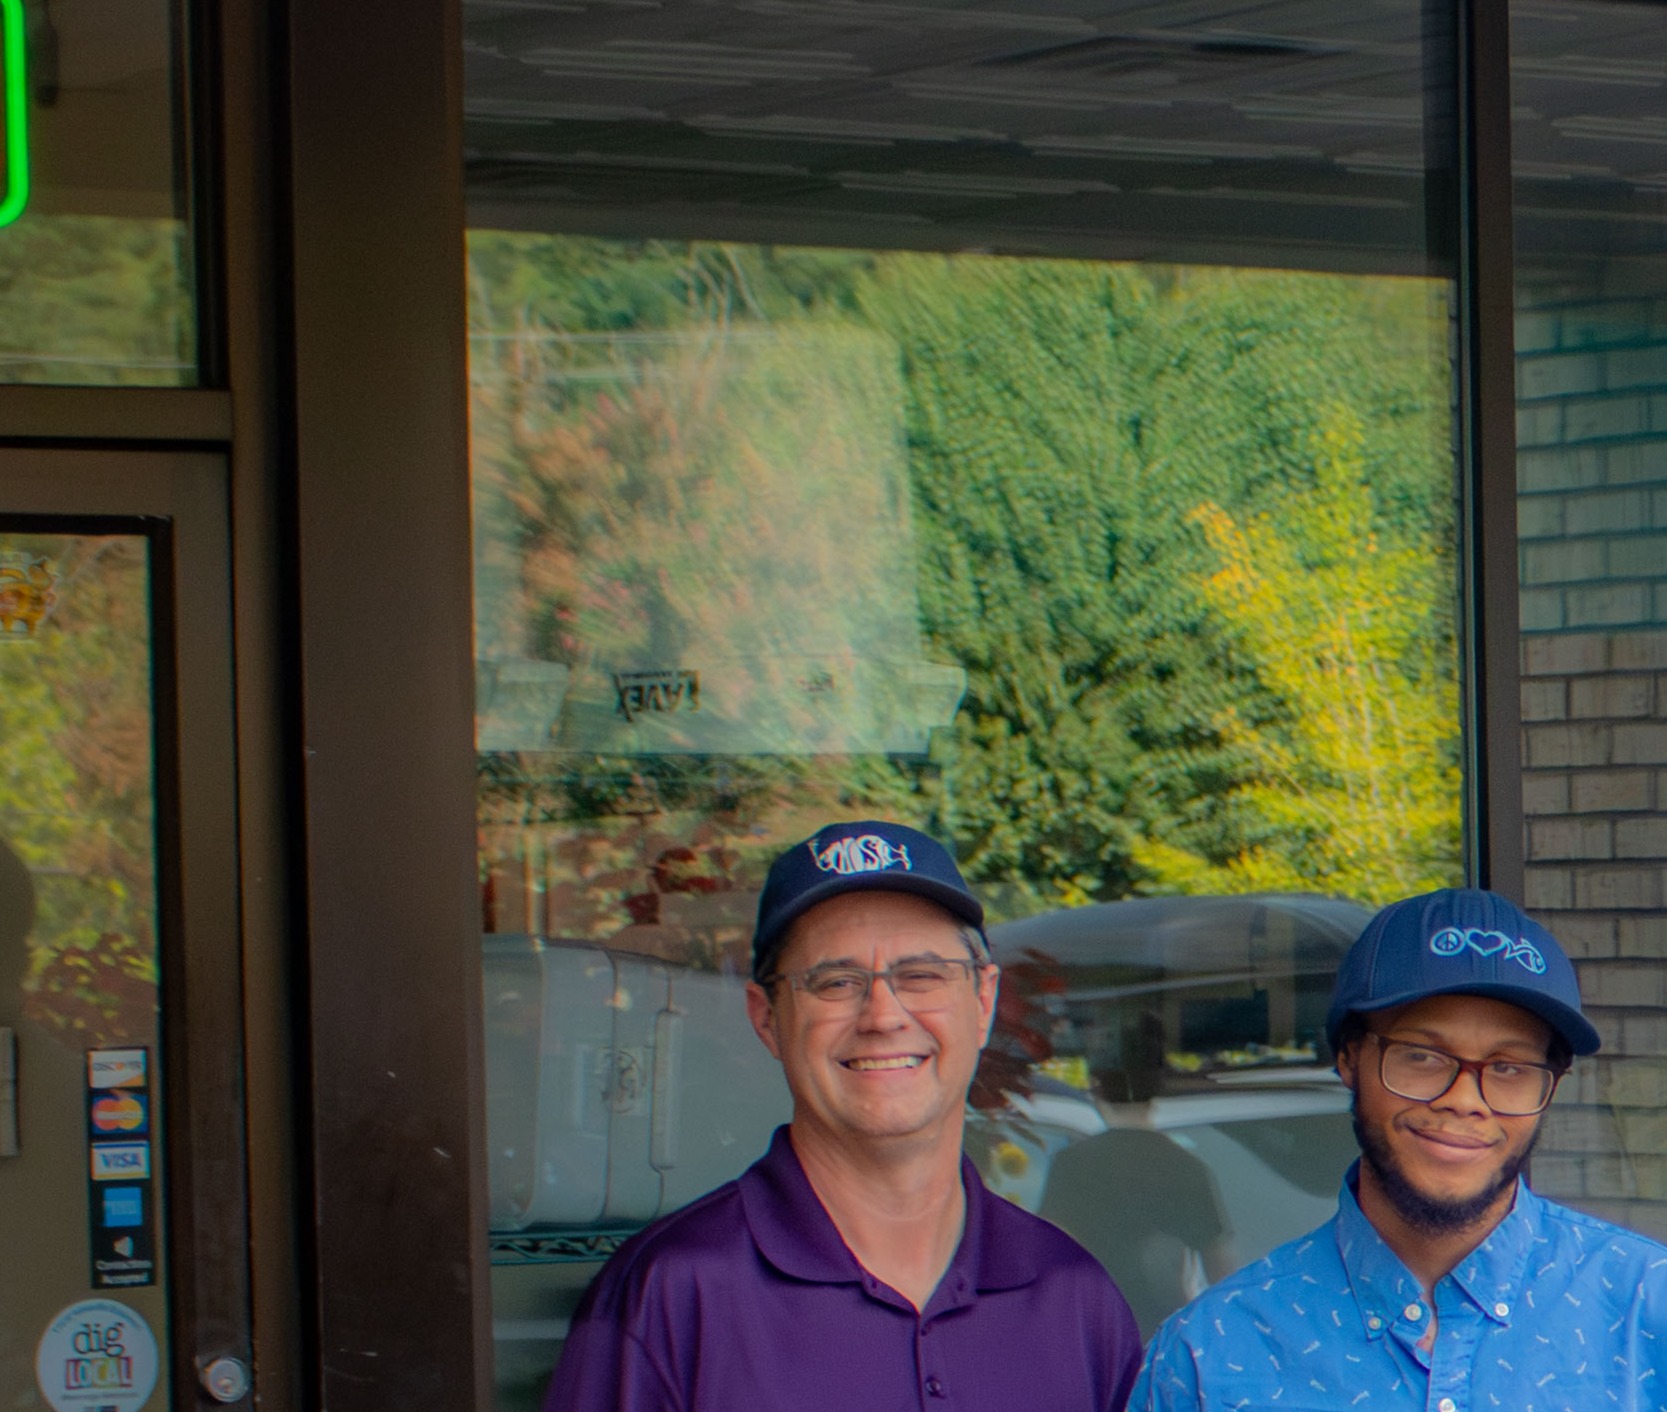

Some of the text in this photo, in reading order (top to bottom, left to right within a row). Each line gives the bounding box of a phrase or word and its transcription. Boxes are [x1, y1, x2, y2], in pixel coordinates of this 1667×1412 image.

[99, 1152, 141, 1168] VISA
[73, 1321, 126, 1357] dig
[65, 1356, 133, 1390] LOCAL
